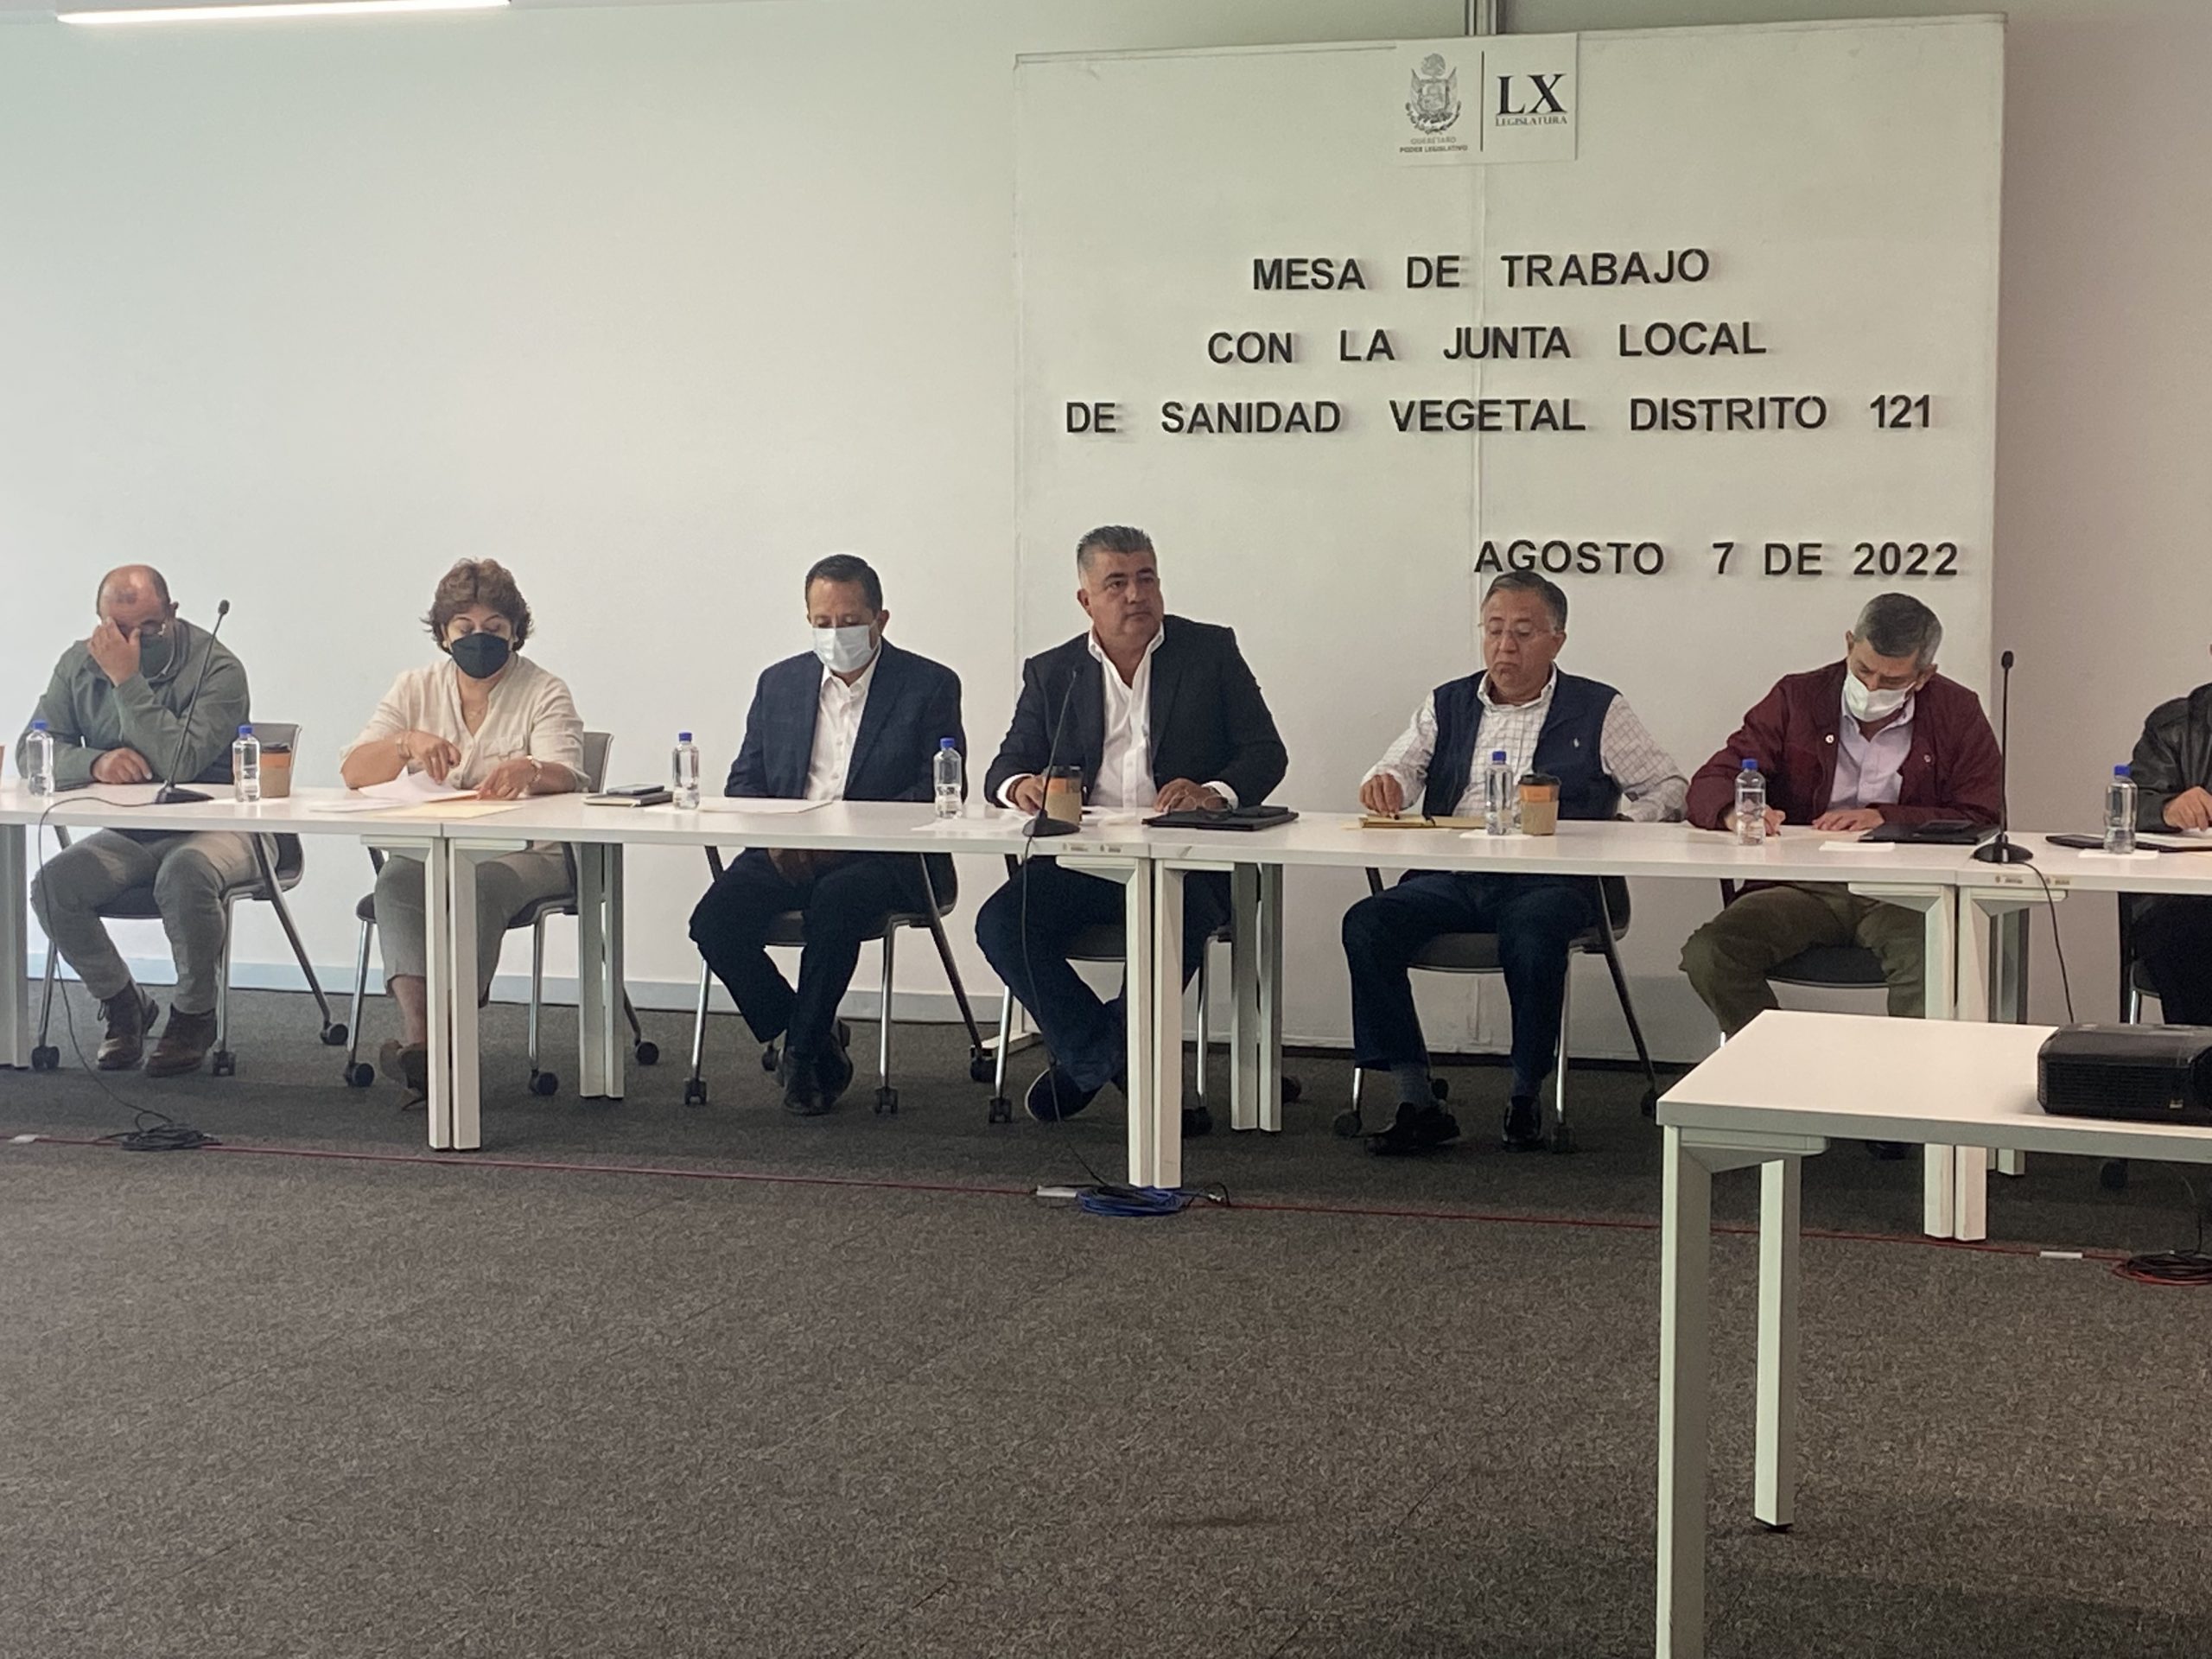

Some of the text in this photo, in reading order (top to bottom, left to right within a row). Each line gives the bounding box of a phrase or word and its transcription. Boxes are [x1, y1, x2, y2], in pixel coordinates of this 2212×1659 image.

[1496, 73, 1567, 114] LX
[1495, 116, 1567, 126] LEGISLATURA
[1254, 248, 1709, 290] MESA DE TRABAJO
[1208, 321, 1767, 364] CON LA JUNTA LOCAL
[1066, 394, 1929, 434] DE SANIDAD VEGETAL DISTRITO 121
[1473, 539, 1957, 576] AGOSTO 7 DE 2022
